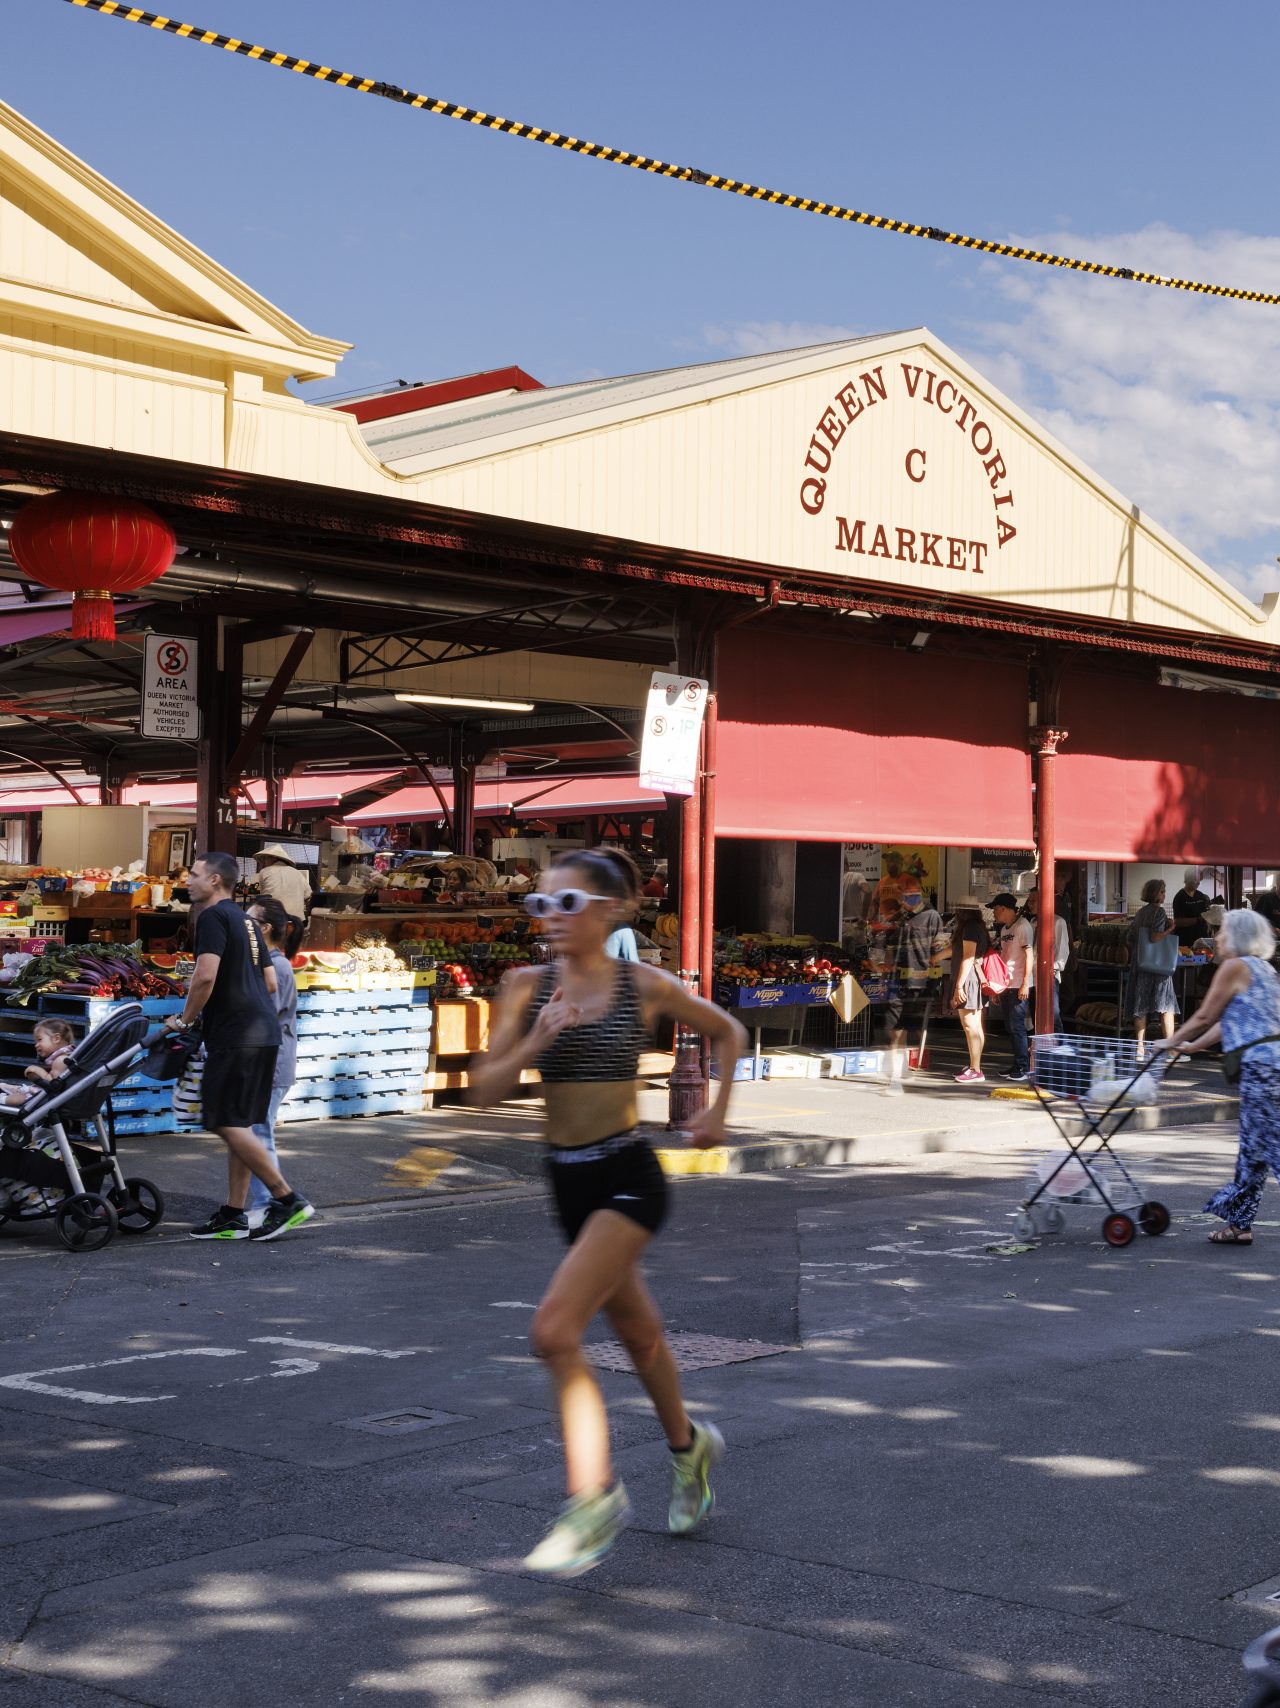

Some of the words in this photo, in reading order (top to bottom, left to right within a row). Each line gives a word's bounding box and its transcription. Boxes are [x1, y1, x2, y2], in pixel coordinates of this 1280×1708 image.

[800, 366, 888, 515] QUEEN
[900, 363, 1017, 549] VICTORIA
[905, 448, 926, 482] C
[835, 516, 988, 574] MARKET
[156, 677, 188, 690] AREA
[147, 691, 166, 699] QUEEN
[169, 693, 196, 702] VICTORIA
[159, 701, 184, 709] MARKET
[153, 709, 190, 718] AUTHORISED
[157, 717, 185, 726] VEHICLES
[155, 725, 186, 734] EXCEPTED
[217, 808, 234, 824] 14
[982, 847, 1009, 857] Workplace
[1008, 849, 1023, 857] Fresh
